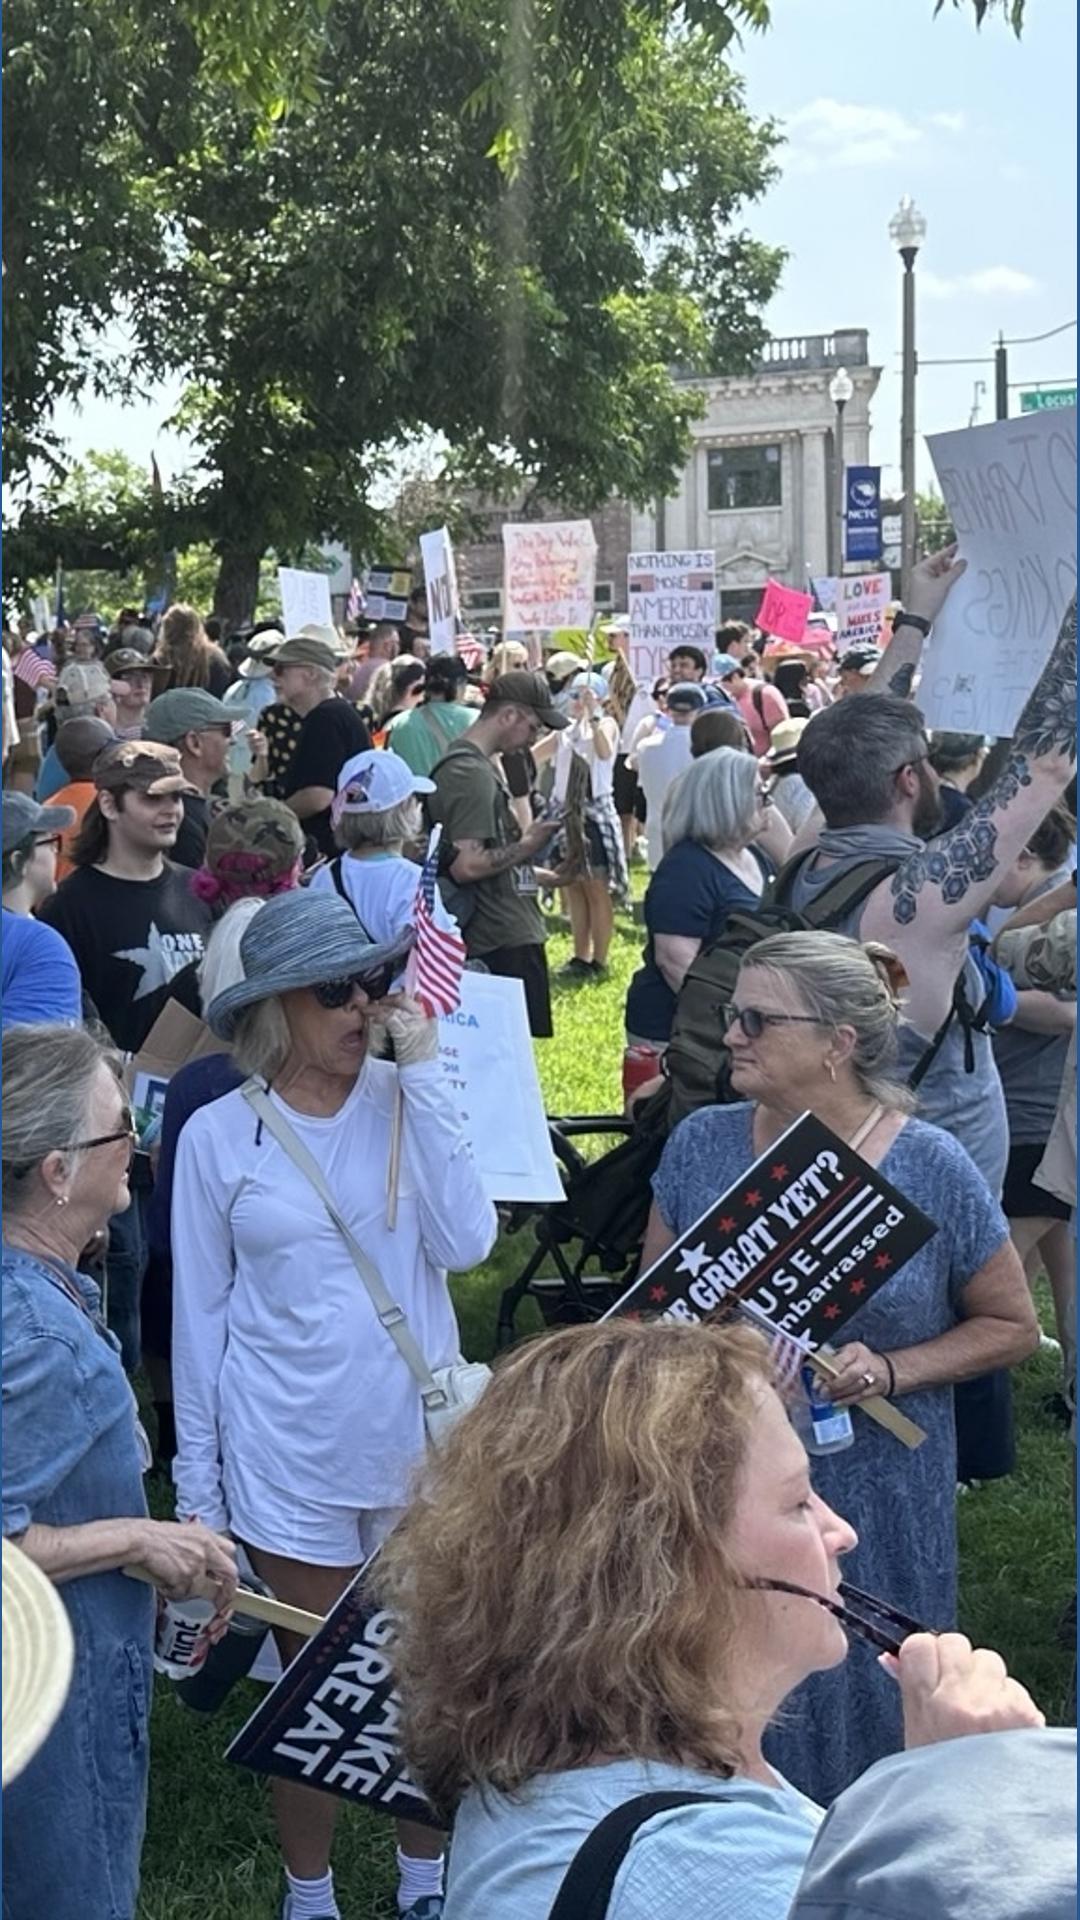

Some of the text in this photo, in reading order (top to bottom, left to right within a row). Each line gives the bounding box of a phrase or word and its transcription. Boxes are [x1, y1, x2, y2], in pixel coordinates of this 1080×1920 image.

[848, 508, 878, 520] NCTC
[630, 553, 714, 569] NOTHING IS
[655, 575, 687, 591] MORE
[844, 578, 881, 601] LOVE
[631, 597, 715, 621] AMERICAN
[846, 609, 881, 628] MAKES
[631, 623, 714, 639] THAN OPPOSING
[839, 624, 882, 640] AMERICA
[162, 932, 204, 952] ONE
[688, 1216, 778, 1312] GREAT
[767, 1150, 844, 1230] YET?
[163, 1620, 201, 1666] hint
[273, 1608, 396, 1777] GREAT
